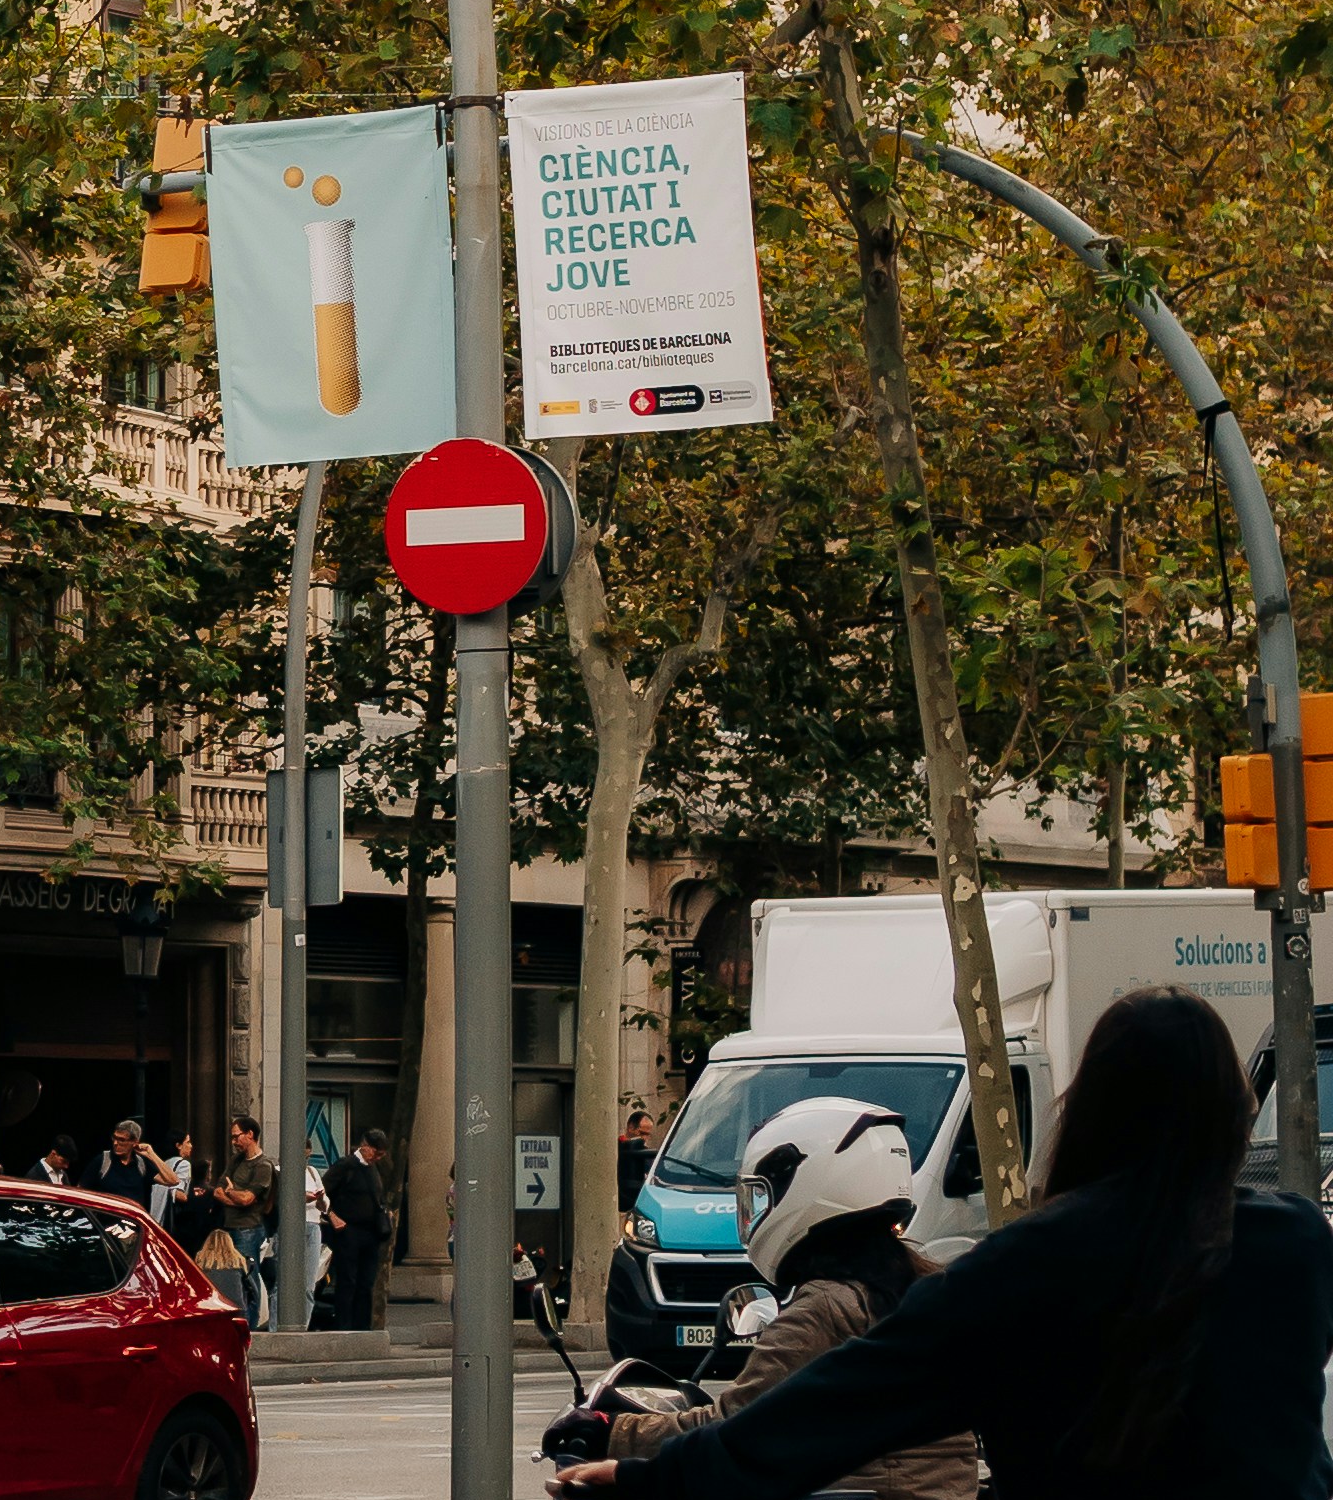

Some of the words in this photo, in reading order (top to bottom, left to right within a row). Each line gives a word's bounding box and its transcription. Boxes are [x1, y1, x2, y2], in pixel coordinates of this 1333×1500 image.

[534, 121, 592, 142] VISIONS
[595, 120, 614, 137] DE
[617, 118, 634, 135] LA
[636, 112, 695, 133] CIÈNCIA
[539, 143, 690, 183] CIÈNCIA,
[541, 182, 658, 220] CIUTAT
[666, 180, 681, 208] I
[544, 216, 697, 256] RECERCA
[546, 258, 631, 292] JOVE
[546, 294, 694, 321] OCTUBRE-NOVEMBRE
[699, 290, 736, 309] 2025
[550, 338, 641, 358] BIBLIOTEQUES
[642, 337, 658, 350] DE
[659, 331, 732, 349] BARCELONA
[550, 352, 715, 375] barcelona.cat/biblioteques
[83, 883, 106, 913] DE
[1175, 934, 1253, 966] Solucions
[1258, 941, 1267, 964] a
[1214, 981, 1252, 997] VEHICLES
